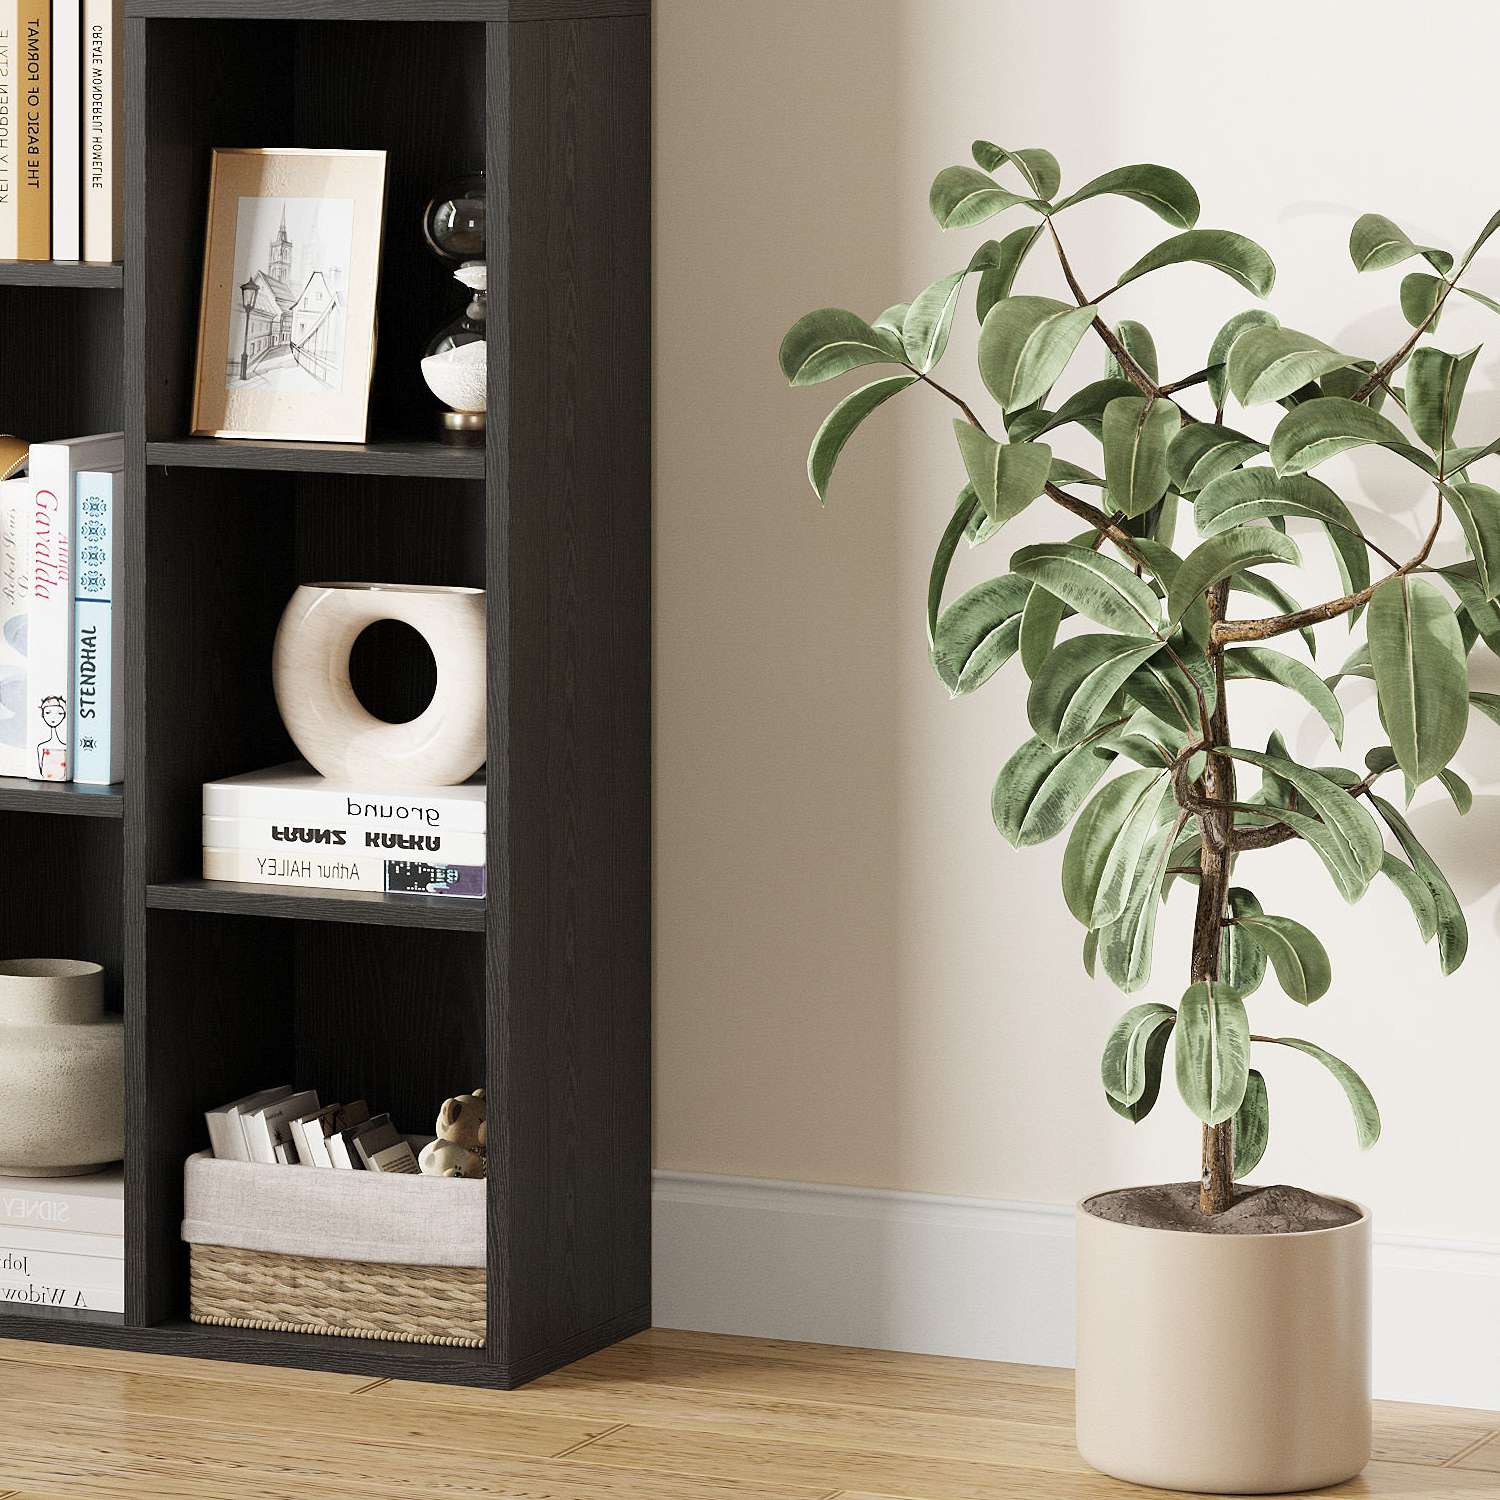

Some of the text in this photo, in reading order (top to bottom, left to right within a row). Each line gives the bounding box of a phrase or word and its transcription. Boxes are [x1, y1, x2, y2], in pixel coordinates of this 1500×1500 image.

[2, 553, 16, 605] Robert
[35, 489, 59, 601] Gavalda
[79, 625, 98, 719] STENDHAL
